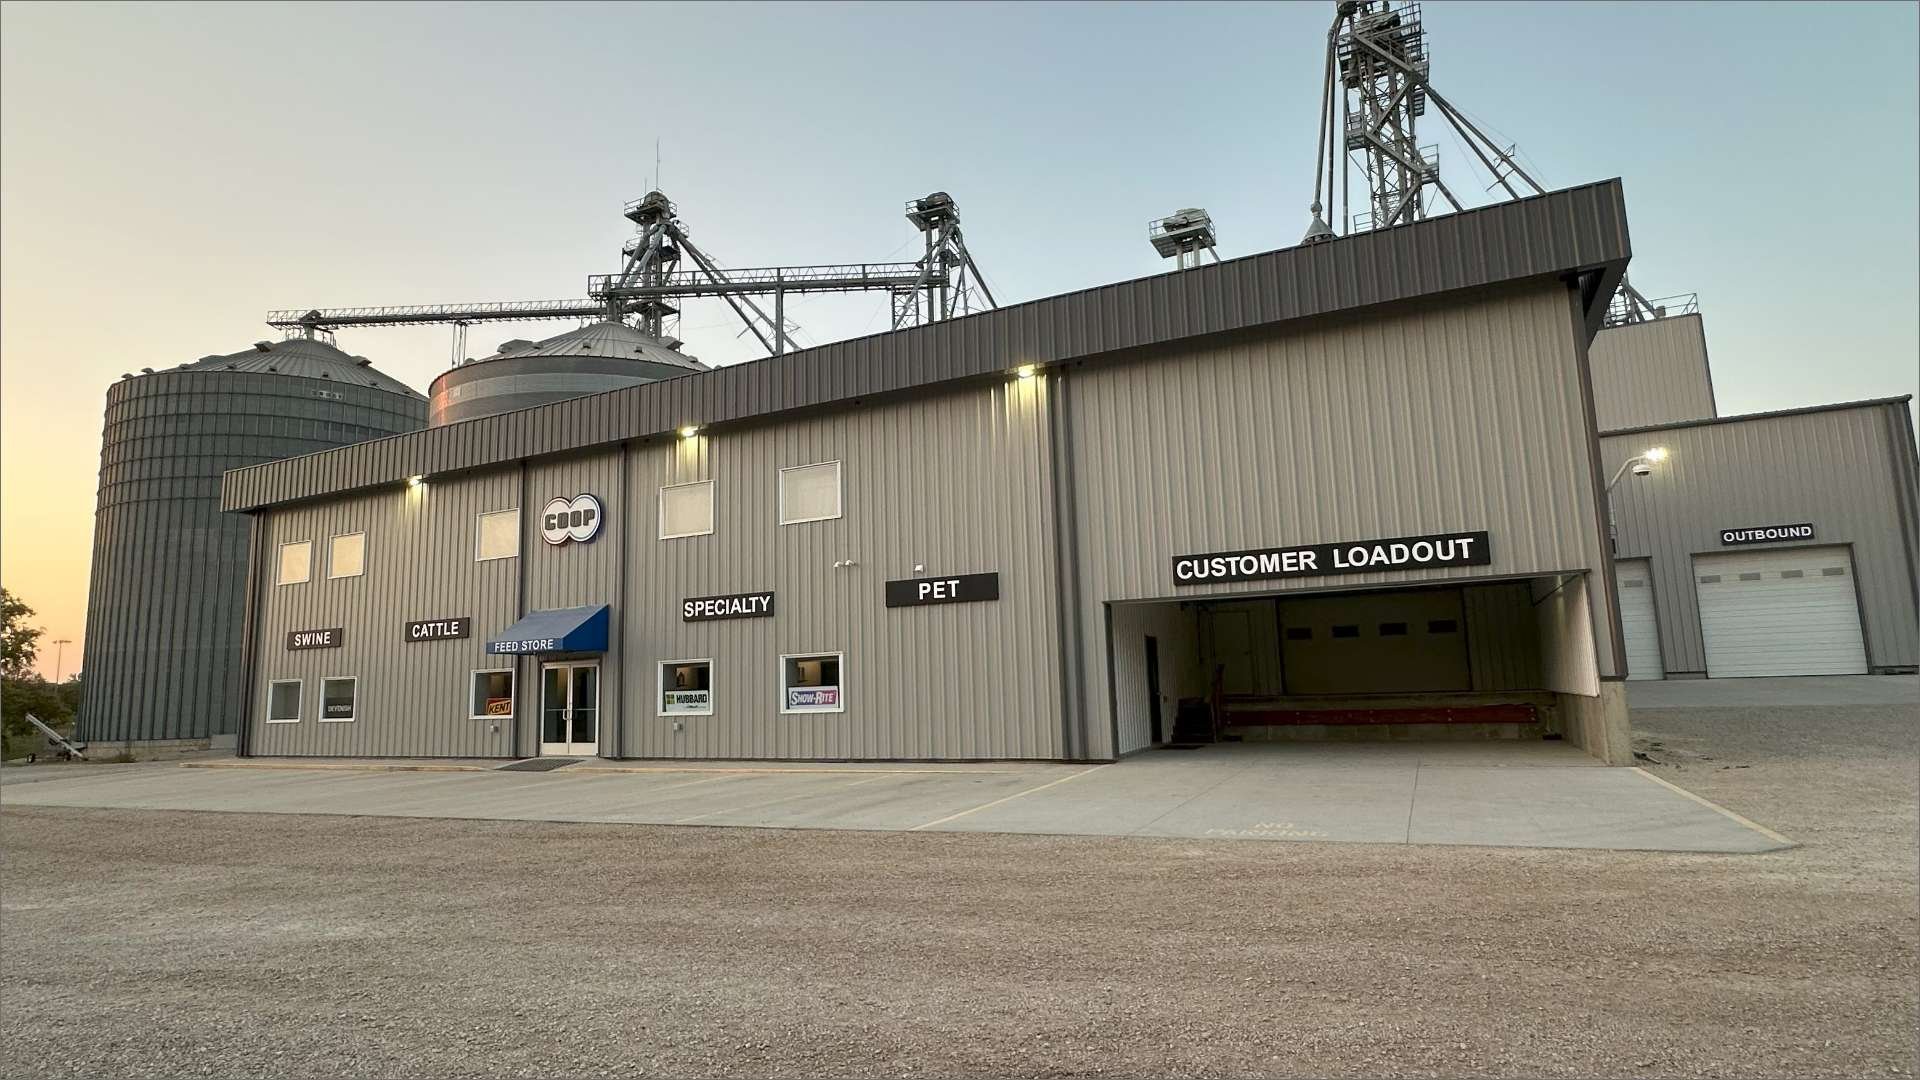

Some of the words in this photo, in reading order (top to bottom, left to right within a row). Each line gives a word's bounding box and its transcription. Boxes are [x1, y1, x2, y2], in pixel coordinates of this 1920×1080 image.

[544, 508, 596, 531] COOP
[1723, 526, 1812, 542] OUTBOUND
[1176, 550, 1318, 580] CUSTOMER
[1333, 537, 1474, 568] LOADOUT
[918, 580, 960, 600] PET
[684, 595, 771, 618] SPECIALTY
[412, 621, 459, 638] CATTLE
[294, 632, 331, 647] SWINE
[494, 641, 518, 652] FEED
[521, 639, 554, 651] STORE
[676, 694, 707, 704] HUBBARD
[489, 702, 511, 714] KENT
